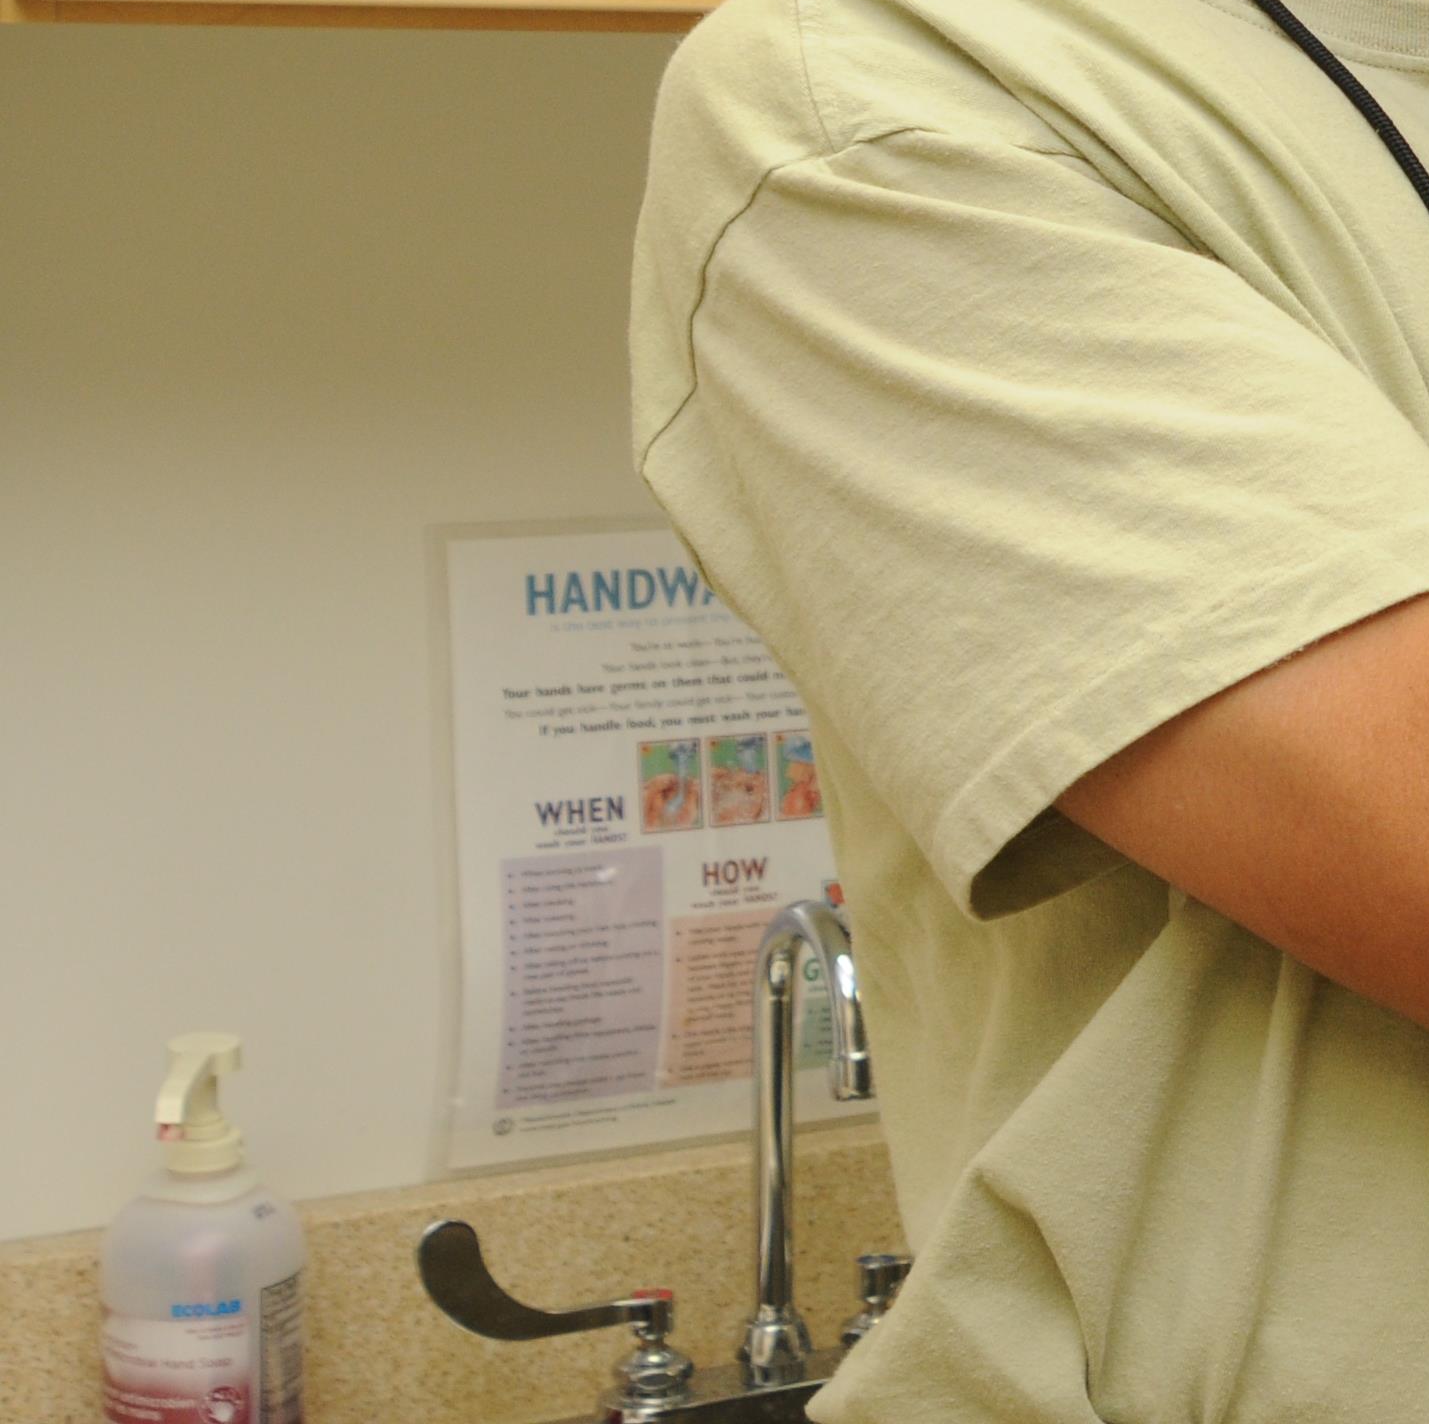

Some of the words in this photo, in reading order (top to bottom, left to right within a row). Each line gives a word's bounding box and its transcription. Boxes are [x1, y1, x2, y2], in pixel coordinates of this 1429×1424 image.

[534, 684, 572, 697] hands
[576, 682, 605, 694] have
[651, 680, 666, 689] on
[671, 675, 703, 688] them
[706, 673, 733, 685] that
[737, 671, 767, 683] could
[552, 724, 575, 736] you
[579, 718, 621, 732] handle
[660, 716, 683, 729] you
[720, 710, 751, 722] wash
[755, 710, 779, 722] your
[535, 796, 626, 827] WHEN
[702, 856, 769, 886] HOW
[171, 1299, 243, 1319] ECOLAB
